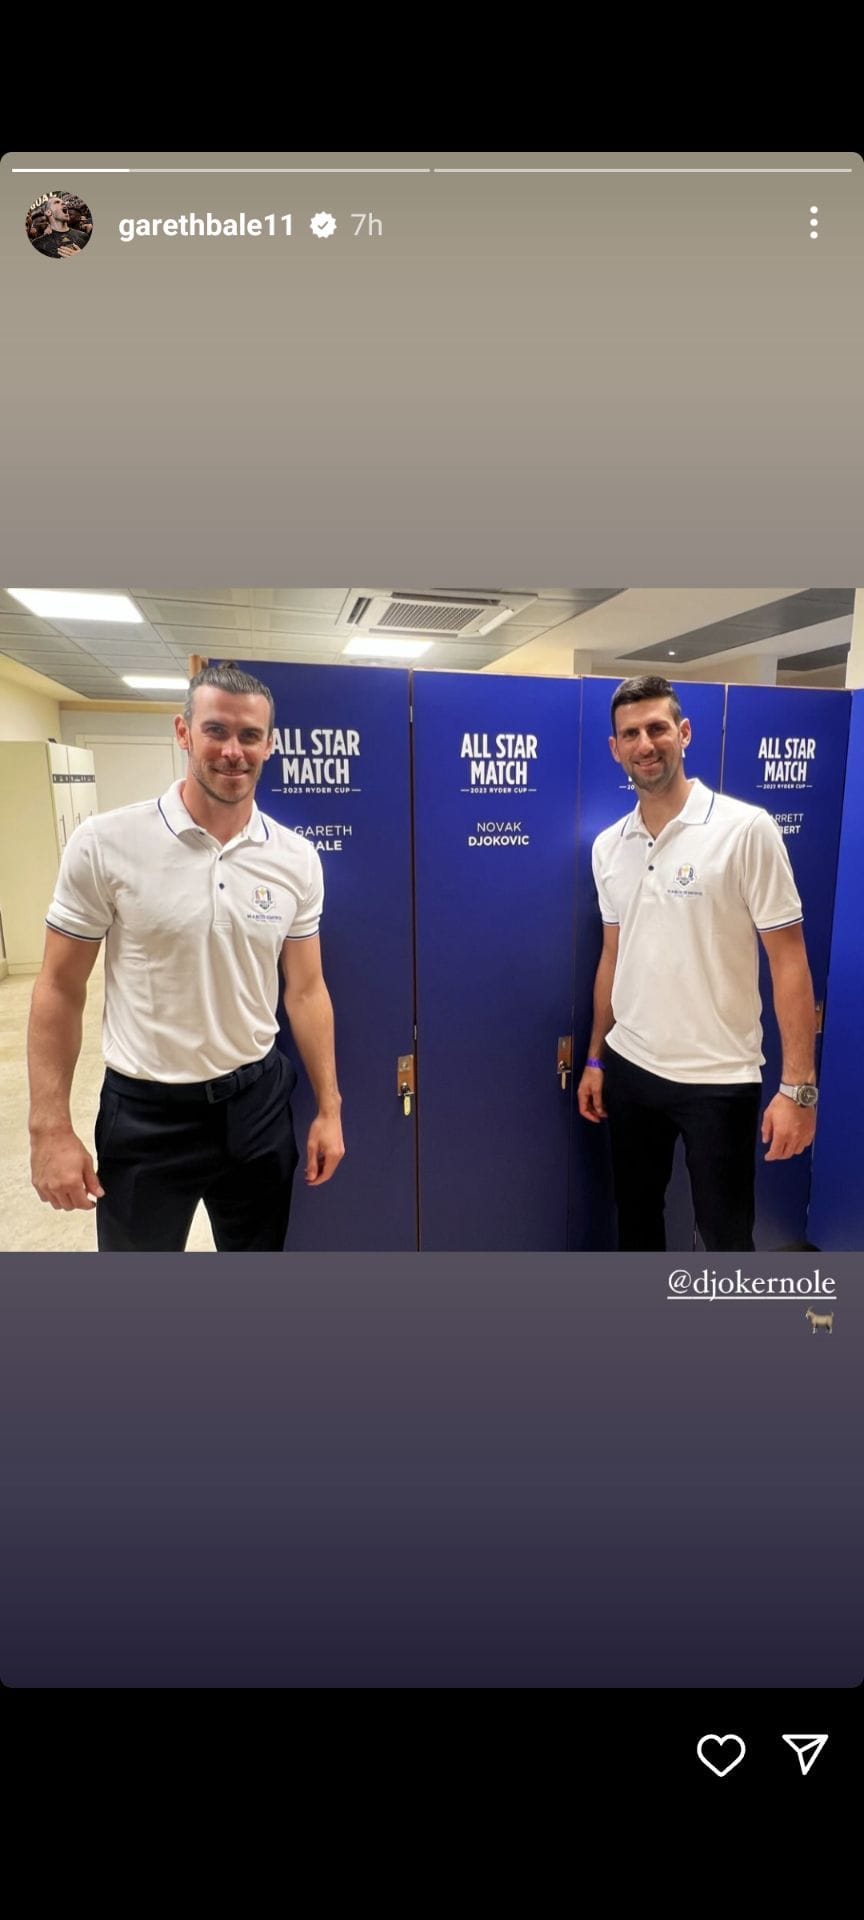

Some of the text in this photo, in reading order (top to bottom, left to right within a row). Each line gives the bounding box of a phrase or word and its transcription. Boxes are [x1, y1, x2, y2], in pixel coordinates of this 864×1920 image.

[272, 728, 361, 756] ALL STAR
[460, 733, 538, 759] ALL STAR
[758, 737, 816, 760] ALL STAR
[282, 757, 350, 785] MATCH
[470, 761, 528, 785] MATCH
[764, 761, 807, 782] MATCH
[293, 825, 353, 837] GARETH
[476, 822, 522, 833] NOVAK
[468, 835, 530, 847] DJOKOVIC
